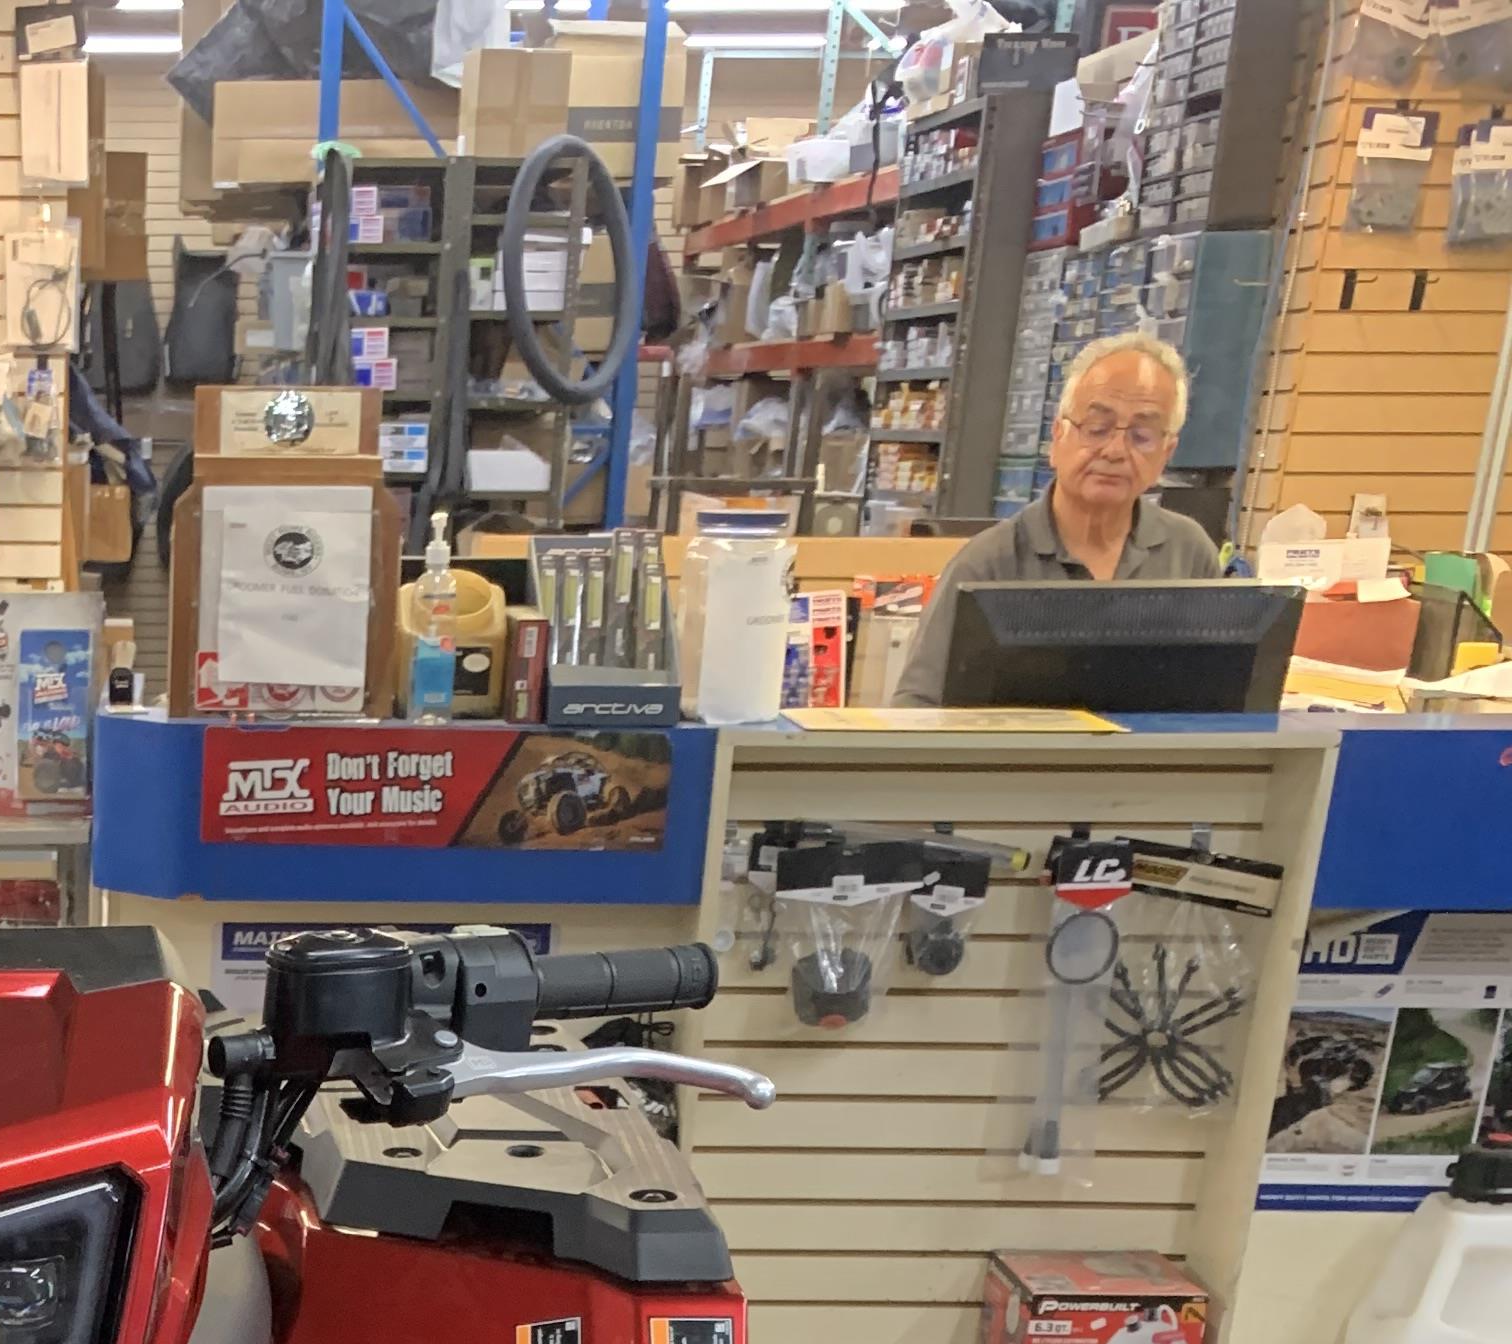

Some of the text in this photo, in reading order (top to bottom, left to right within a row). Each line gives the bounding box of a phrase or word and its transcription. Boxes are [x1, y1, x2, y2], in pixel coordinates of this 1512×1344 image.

[562, 703, 664, 715] arctiva
[327, 751, 454, 782] Don't Forget
[222, 758, 311, 801] MTX
[223, 801, 308, 814] AUDIO
[327, 784, 444, 816] Your Music
[1073, 858, 1127, 883] LC
[1039, 1300, 1141, 1315] POWERBUILT
[1034, 1322, 1053, 1333] 6.3
